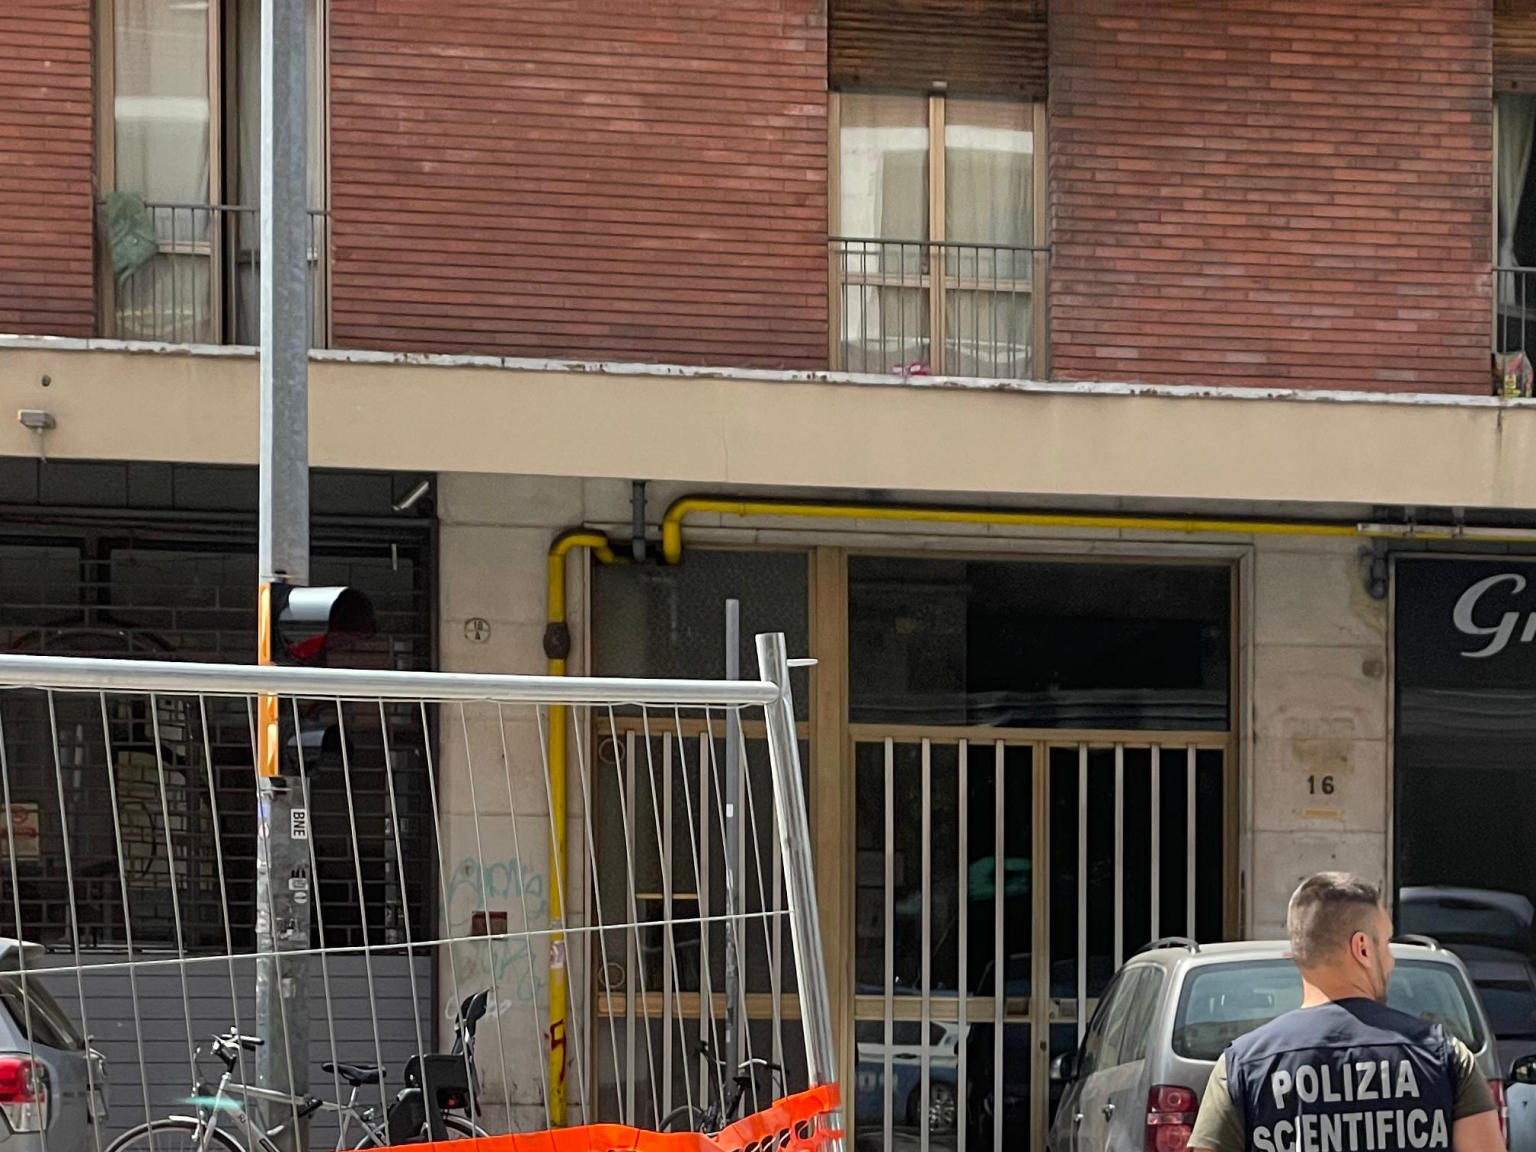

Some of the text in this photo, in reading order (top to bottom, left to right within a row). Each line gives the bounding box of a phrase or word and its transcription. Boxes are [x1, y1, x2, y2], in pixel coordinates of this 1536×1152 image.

[1307, 775, 1335, 795] 16
[293, 811, 306, 836] BNE
[1271, 1059, 1420, 1110] POLIZIA
